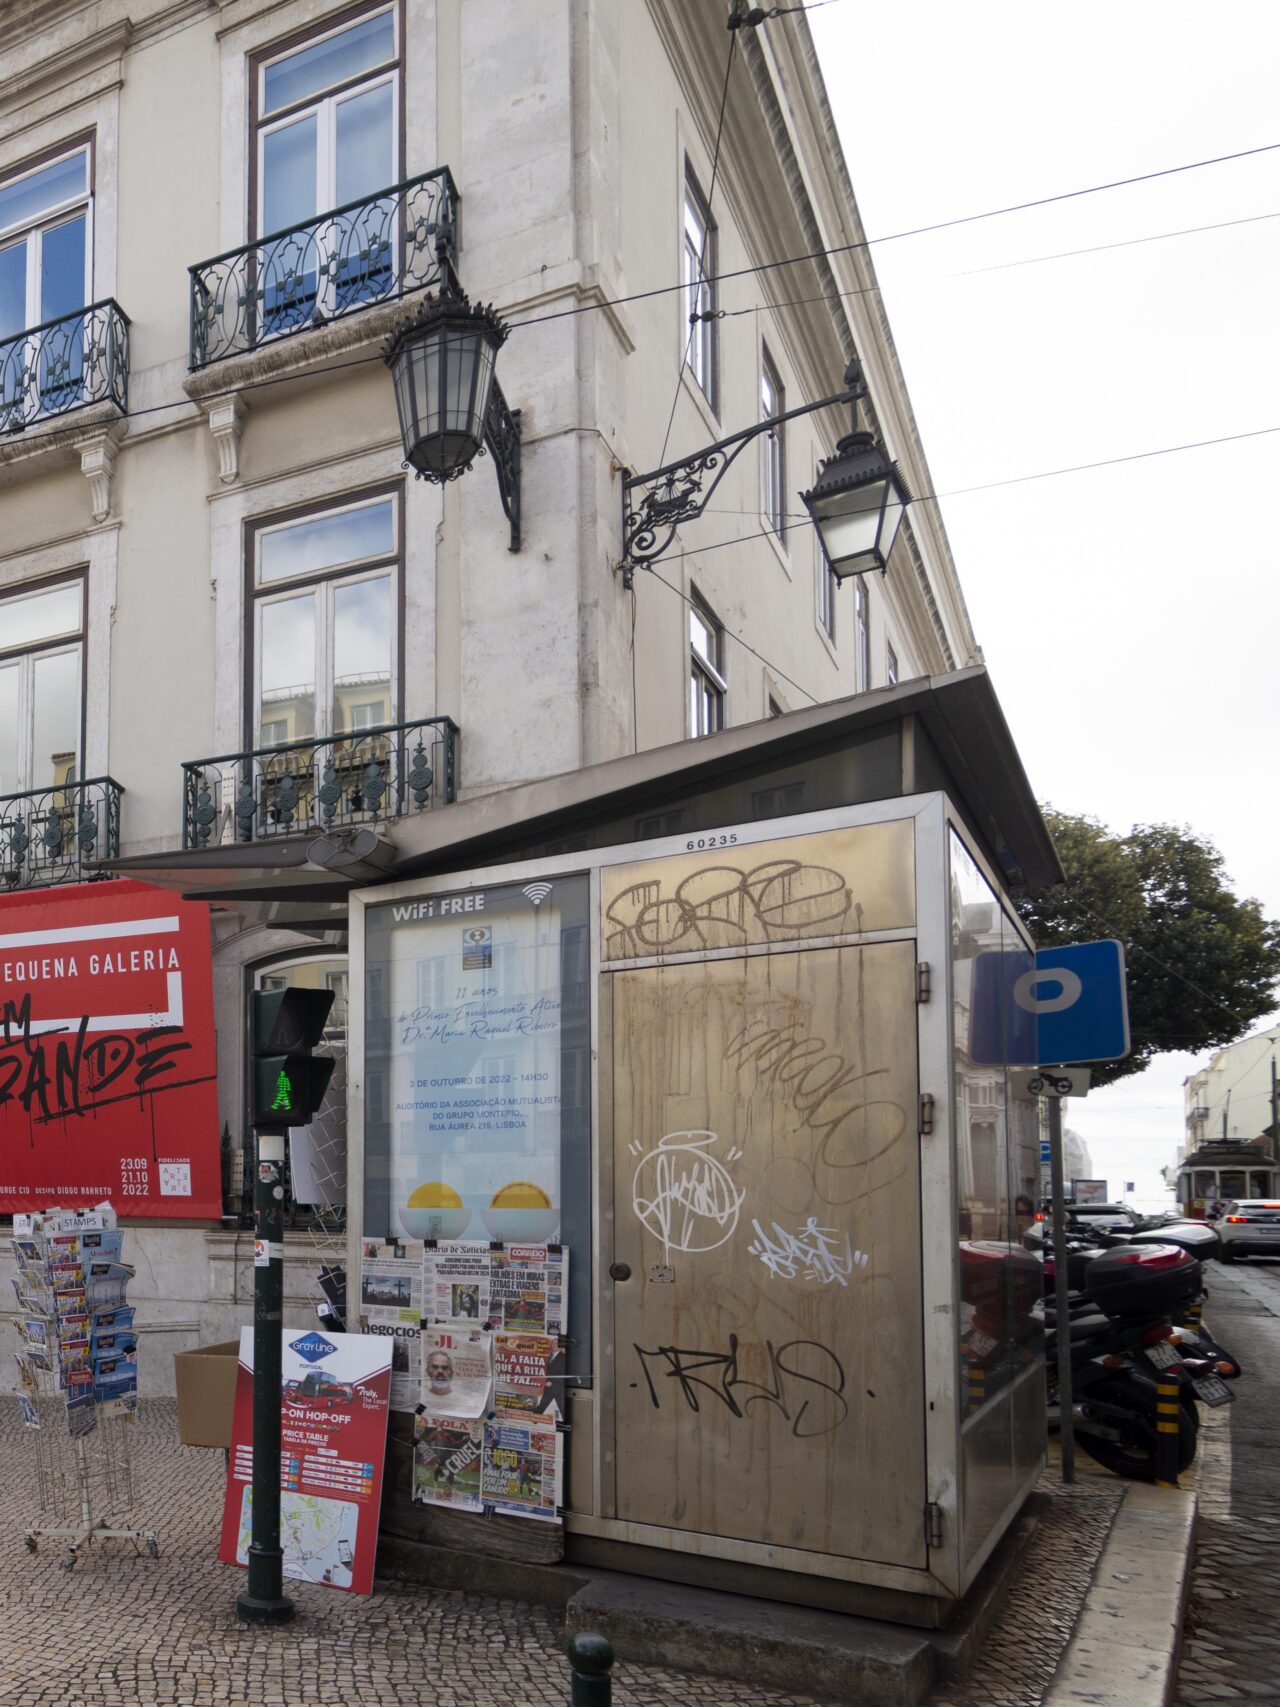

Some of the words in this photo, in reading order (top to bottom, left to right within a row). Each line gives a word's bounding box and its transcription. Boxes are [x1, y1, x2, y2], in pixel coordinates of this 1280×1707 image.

[686, 833, 738, 850] 60235
[392, 900, 434, 922] WiFi
[440, 894, 485, 915] FREE
[90, 948, 180, 975] GALERIA
[472, 986, 498, 998] anos
[430, 1024, 465, 1044] Maria
[470, 1019, 513, 1040] Raquel
[516, 1016, 558, 1036] Ribeiro
[410, 1080, 414, 1088] 3
[417, 1080, 428, 1088] DE
[430, 1077, 472, 1087] OUTUBRO
[476, 1076, 487, 1084] DE
[490, 1075, 511, 1084] 2022
[520, 1072, 549, 1082] 14H30
[396, 1100, 438, 1110] AUDITÓRIO
[440, 1101, 451, 1109] DA
[453, 1097, 506, 1110] ASSOCIAÇÃO
[432, 1112, 444, 1120] DO
[446, 1112, 474, 1120] GRUPO
[428, 1123, 446, 1131] RUA
[448, 1120, 476, 1130] ÁUREA
[496, 1120, 526, 1128] LISBOA
[120, 1159, 147, 1170] 23.09
[121, 1172, 148, 1183] 21.10
[18, 1186, 30, 1194] CID
[57, 1186, 79, 1195] DIOGO
[81, 1187, 112, 1195] BARRETO
[122, 1184, 149, 1196] 2022
[64, 1218, 97, 1227] STAMPS
[490, 1270, 515, 1279] MILHÕES
[516, 1271, 526, 1280] EM
[526, 1272, 545, 1281] HORAS
[490, 1280, 511, 1289] EXTRAS
[512, 1281, 516, 1289] E
[516, 1281, 540, 1290] VIAGENS
[510, 1354, 517, 1363] A
[520, 1356, 545, 1366] FALTA
[496, 1364, 512, 1372] QUE
[524, 1366, 545, 1376] RITA
[306, 1411, 352, 1424] HOP-OFF
[282, 1429, 304, 1438] PRICE
[306, 1432, 328, 1442] TABLE
[445, 1441, 481, 1474] CRUEL
[484, 1468, 500, 1478] FINAL
[483, 1484, 508, 1494] CANUDO
